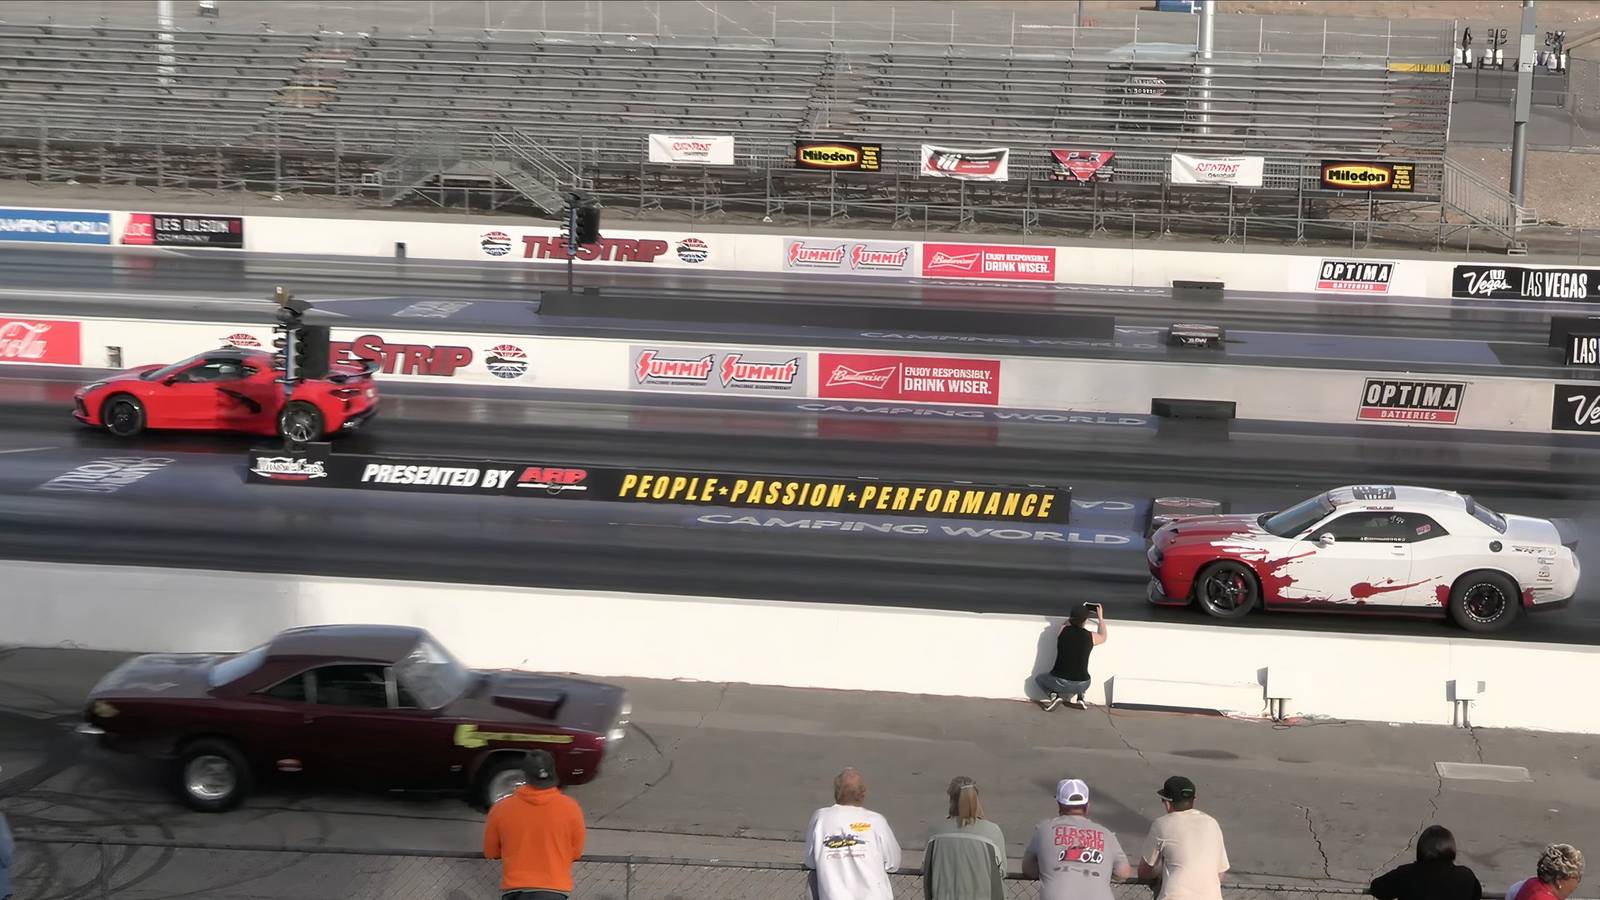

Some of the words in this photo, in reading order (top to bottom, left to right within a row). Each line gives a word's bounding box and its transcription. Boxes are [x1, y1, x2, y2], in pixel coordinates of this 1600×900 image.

[802, 149, 856, 163] Milodon
[1328, 169, 1386, 183] Milodon
[155, 217, 181, 232] LES
[183, 219, 230, 234] OLSON
[985, 261, 1016, 273] DRINK
[1017, 262, 1050, 273] WISER.
[1322, 263, 1388, 281] OPTIMA
[1462, 271, 1513, 297] Vegas
[1520, 271, 1542, 297] LAS
[1544, 272, 1588, 299] VEGAS
[352, 334, 473, 377] STRIP
[1572, 337, 1597, 364] LAS
[832, 369, 888, 383] Budweiser
[905, 366, 931, 377] ENJOY
[932, 367, 993, 381] RESPONSIBLY.
[904, 377, 945, 393] DRINK
[947, 380, 993, 395] WISER.
[1366, 384, 1458, 408] OPTIMA
[796, 403, 985, 419] CAMPING
[992, 411, 1148, 425] WORLD
[1381, 410, 1438, 421] BATTERIES
[361, 463, 480, 488] PRESENTED
[481, 469, 515, 488] BY
[518, 466, 588, 484] ARP
[618, 474, 719, 502] PEOPLE
[729, 479, 846, 508] PASSION
[857, 486, 1056, 519] PERFORMANCE
[696, 514, 929, 535] CAMPING
[940, 525, 1131, 546] WORLD
[1055, 825, 1104, 842] CLASSIC
